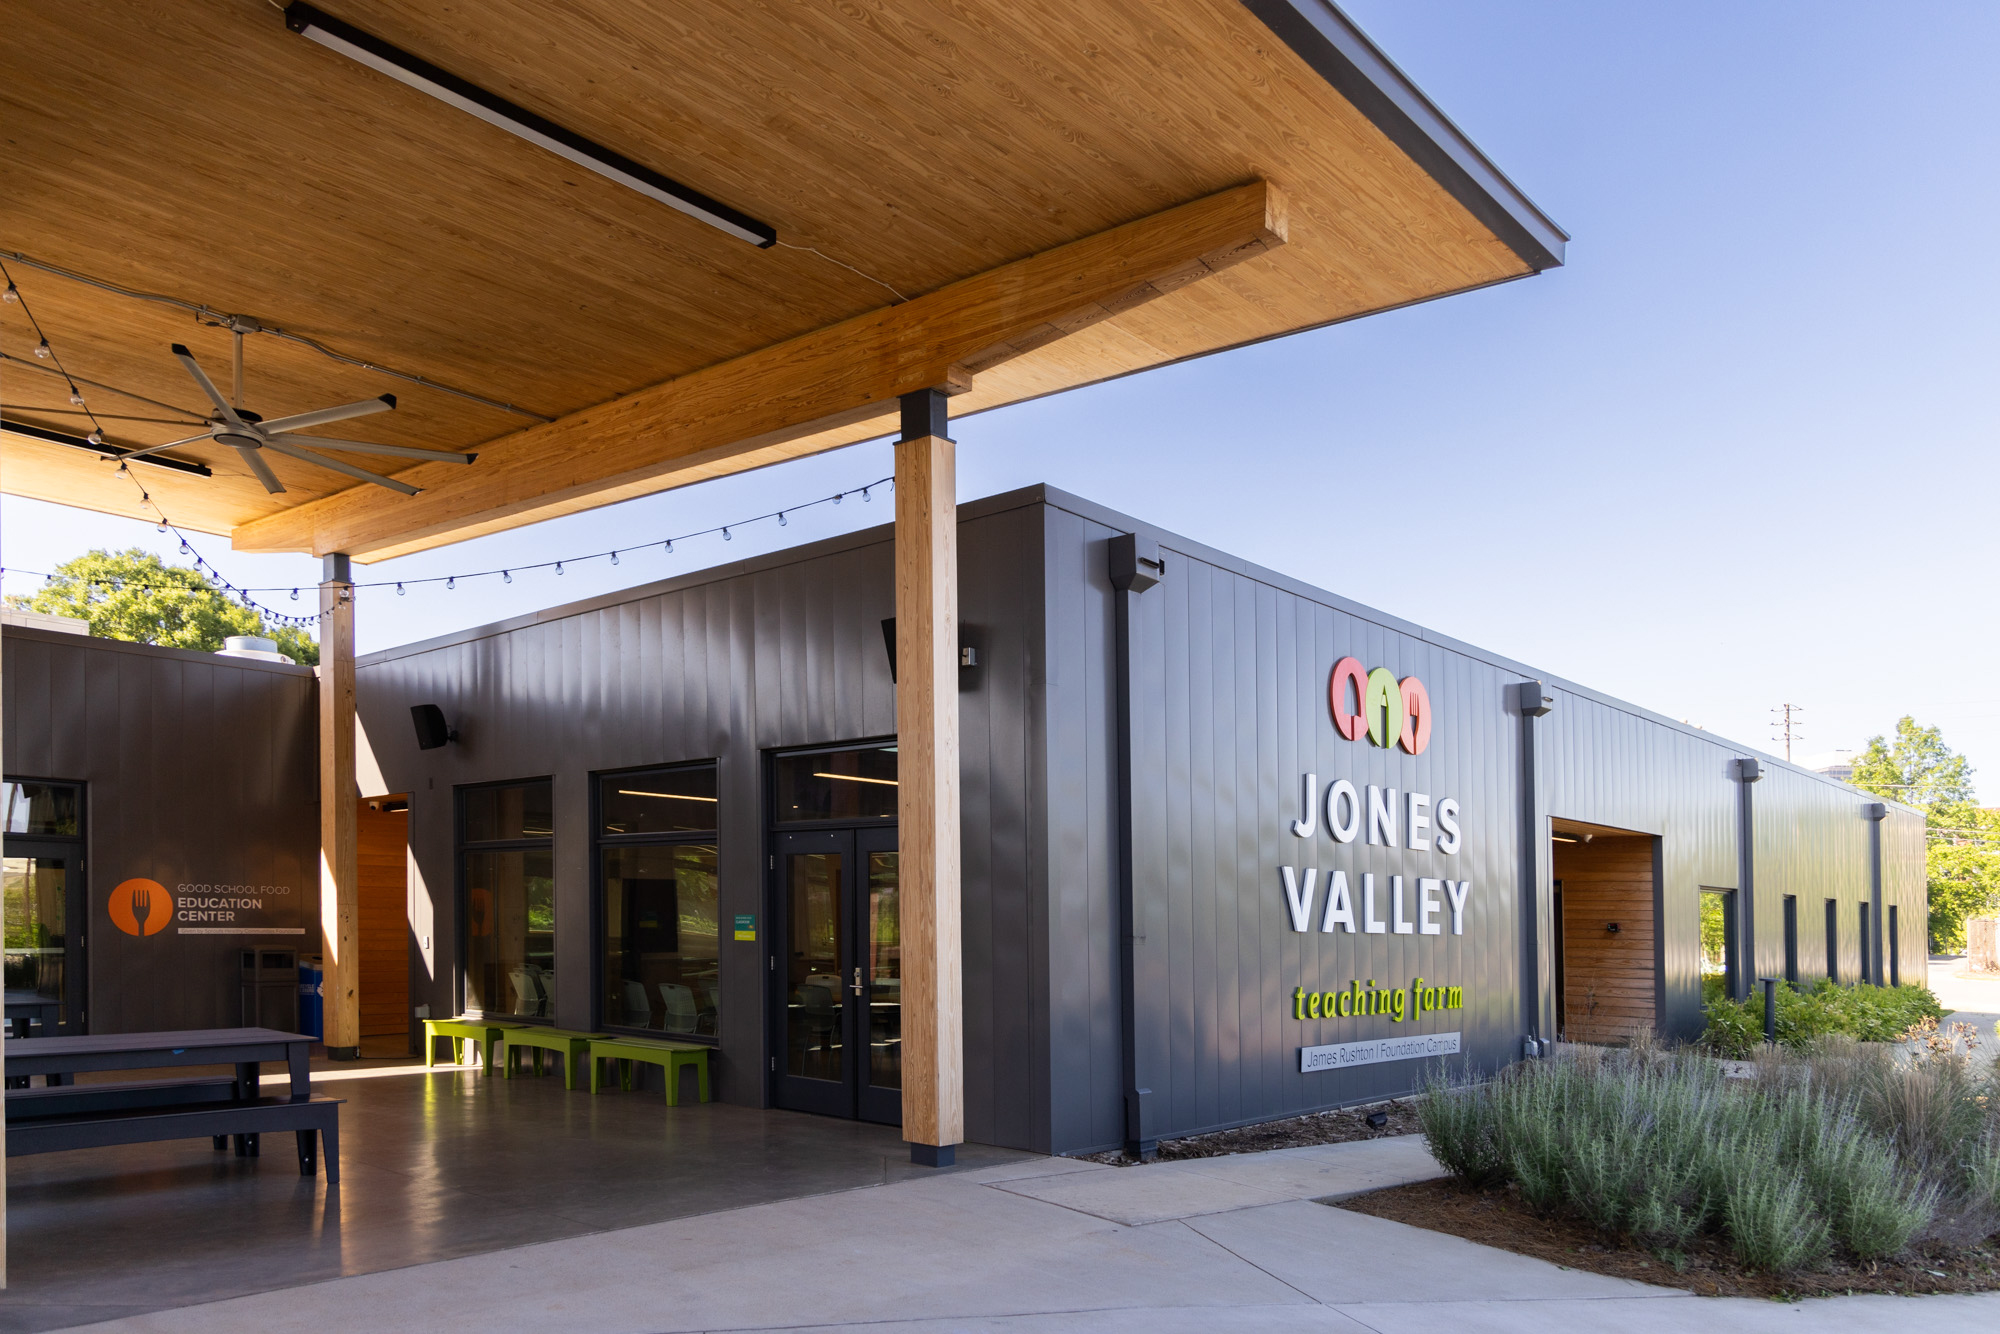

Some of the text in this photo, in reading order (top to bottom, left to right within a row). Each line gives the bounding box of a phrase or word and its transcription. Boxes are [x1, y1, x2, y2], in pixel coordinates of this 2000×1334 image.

[1294, 773, 1462, 855] JONES
[177, 897, 262, 909] EDUCATION
[178, 884, 290, 895] GOOD SCHOOL FOOD
[1280, 865, 1470, 936] VALLEY
[177, 910, 235, 922] CENTER
[1294, 977, 1463, 1023] teaching farm
[1307, 1051, 1337, 1068] James
[1339, 1047, 1374, 1063] Rushton
[1380, 1041, 1425, 1058] Foundation
[1426, 1038, 1457, 1054] Campus
